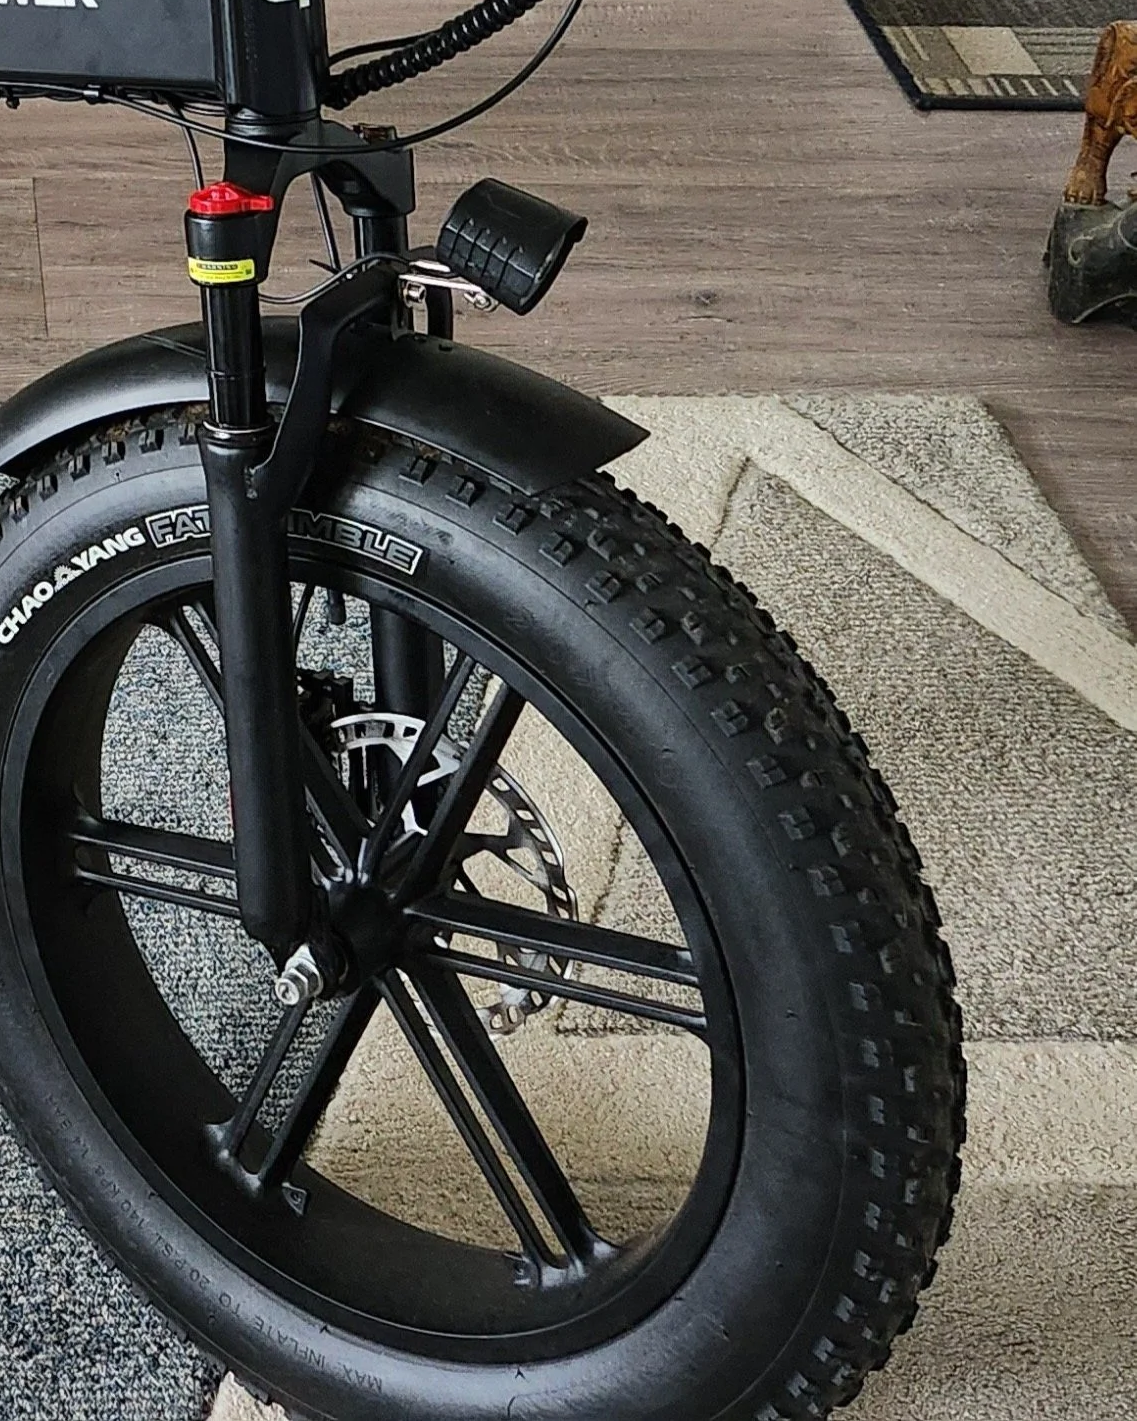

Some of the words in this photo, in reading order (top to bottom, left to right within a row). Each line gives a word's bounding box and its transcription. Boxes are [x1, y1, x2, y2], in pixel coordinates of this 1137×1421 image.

[286, 512, 416, 569] IMBLE
[120, 1199, 145, 1228] 140
[189, 1268, 211, 1289] 20
[219, 1292, 242, 1317] TO
[254, 1313, 326, 1369] INFLATE
